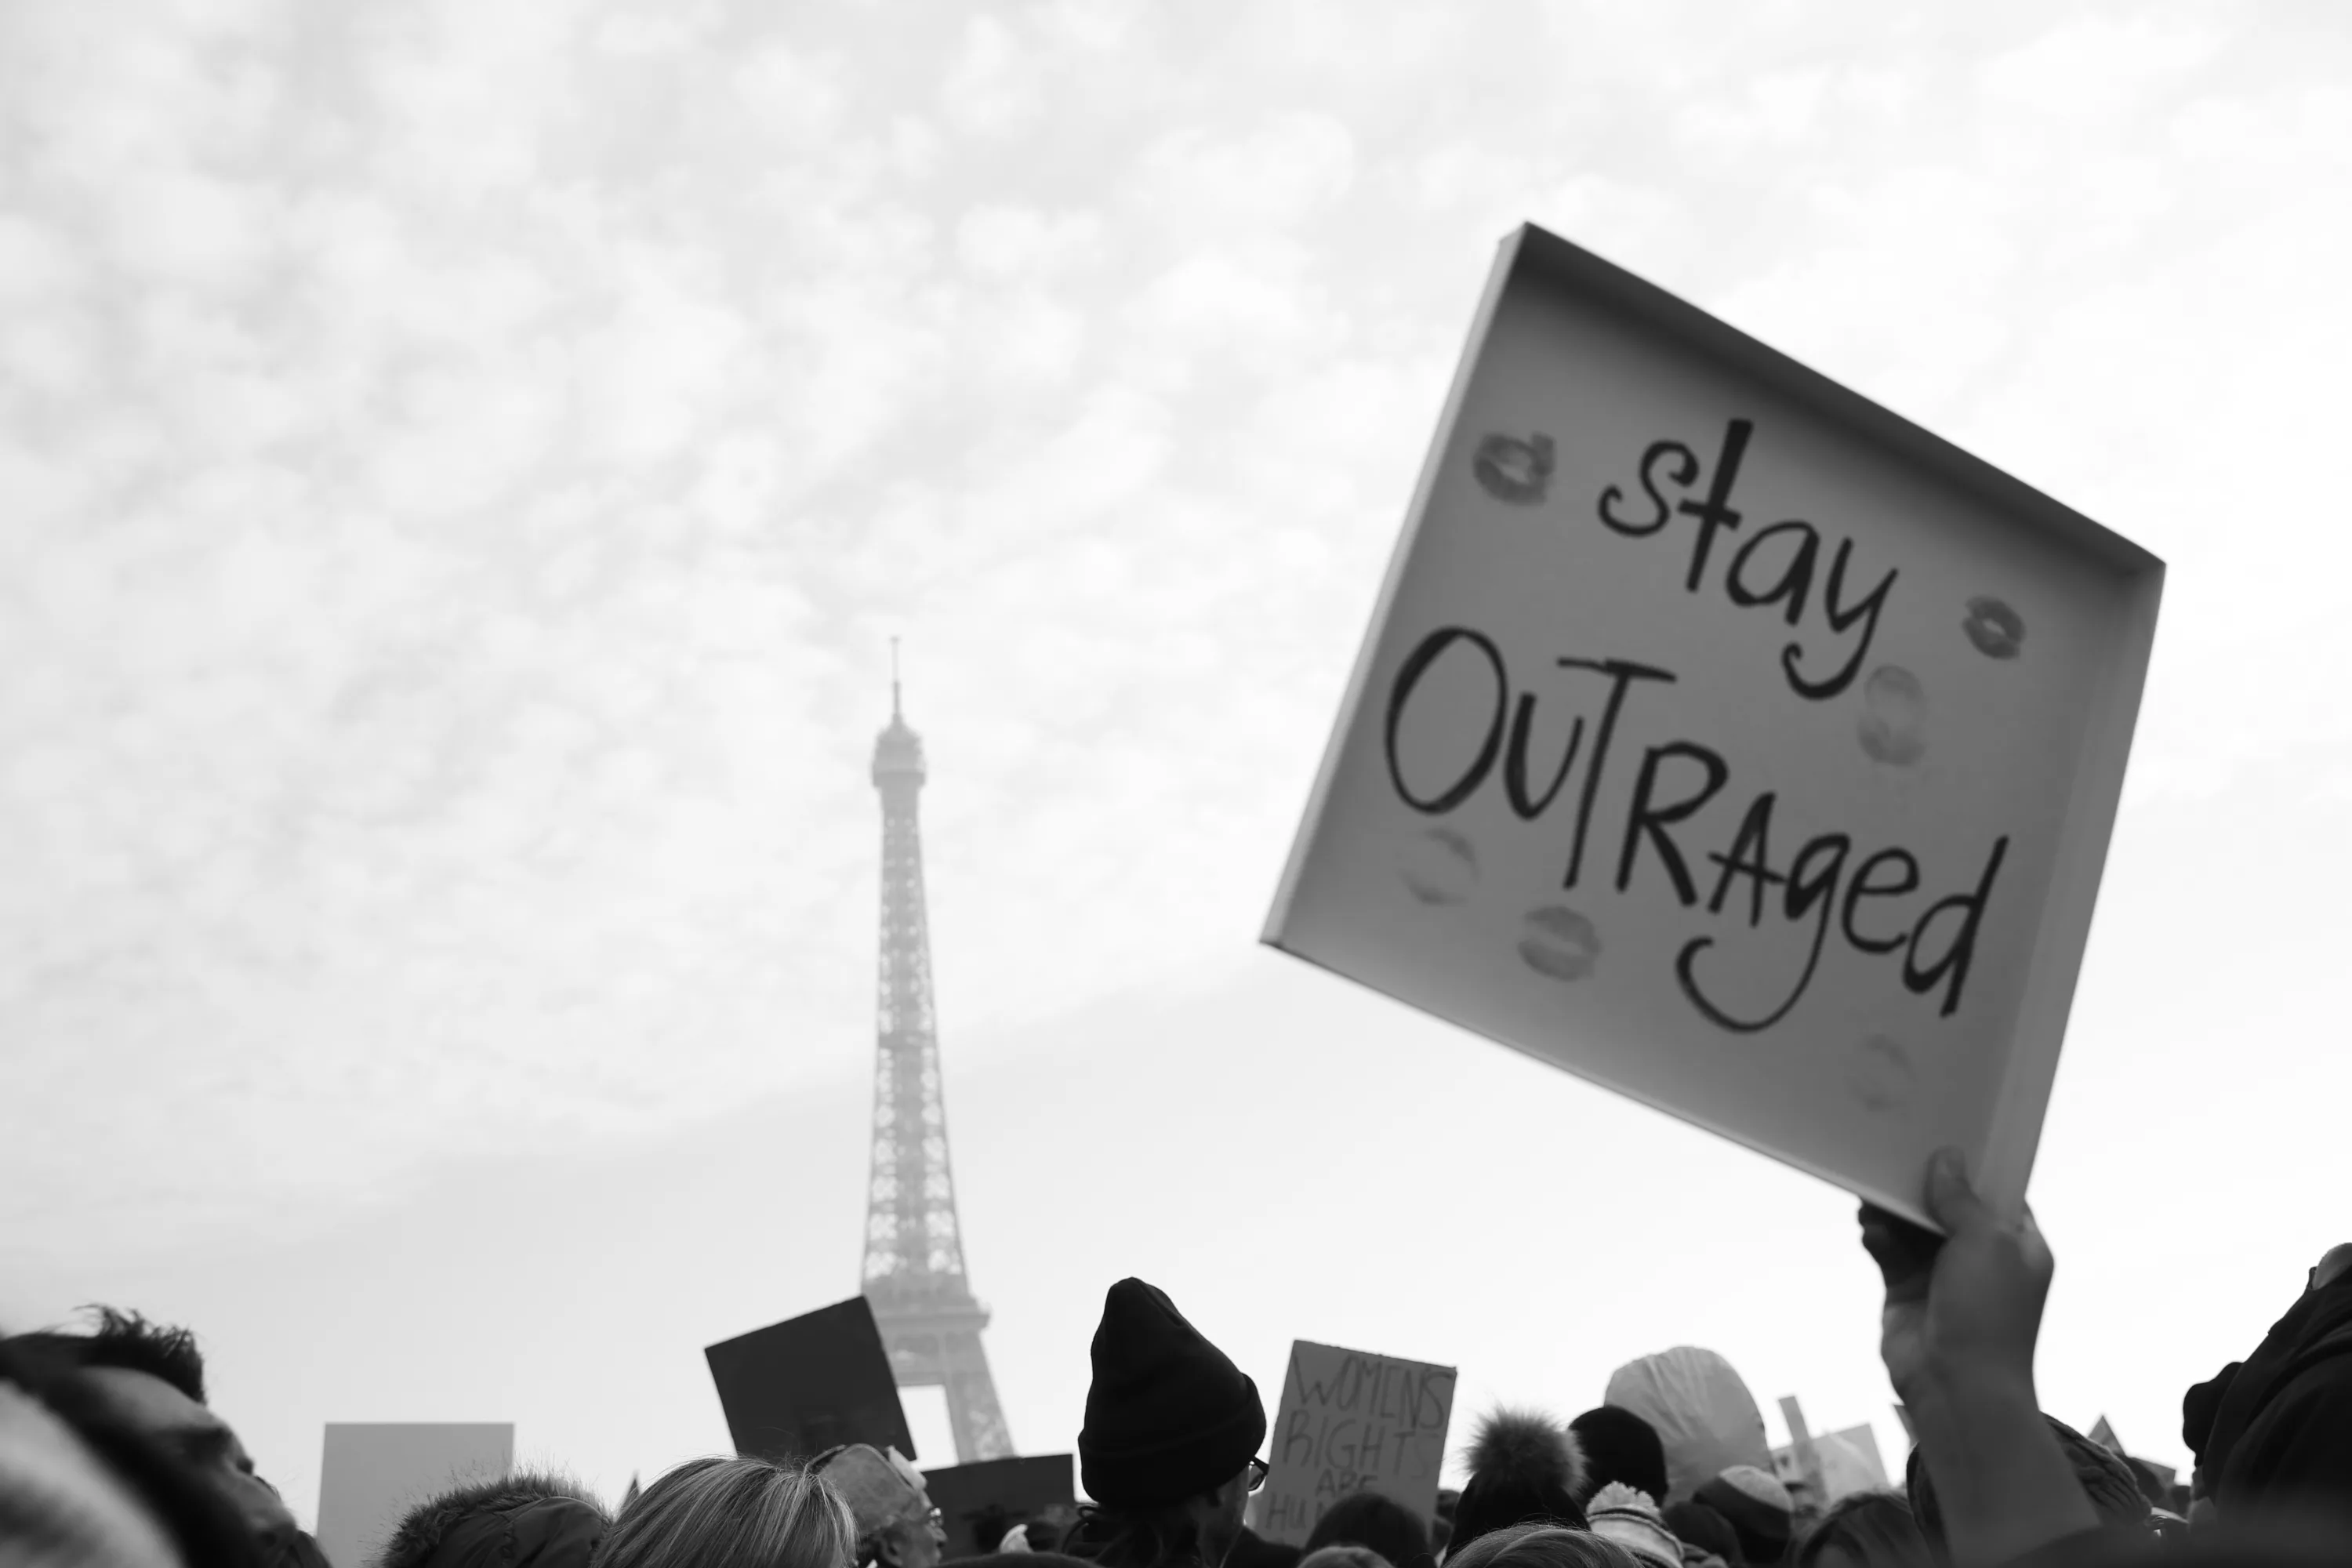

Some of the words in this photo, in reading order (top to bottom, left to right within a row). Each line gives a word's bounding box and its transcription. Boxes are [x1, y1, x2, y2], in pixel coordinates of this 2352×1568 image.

[1597, 416, 1898, 701] stay
[1385, 626, 2009, 1033] OUTRAged
[1283, 1409, 1440, 1480] RIGHTS
